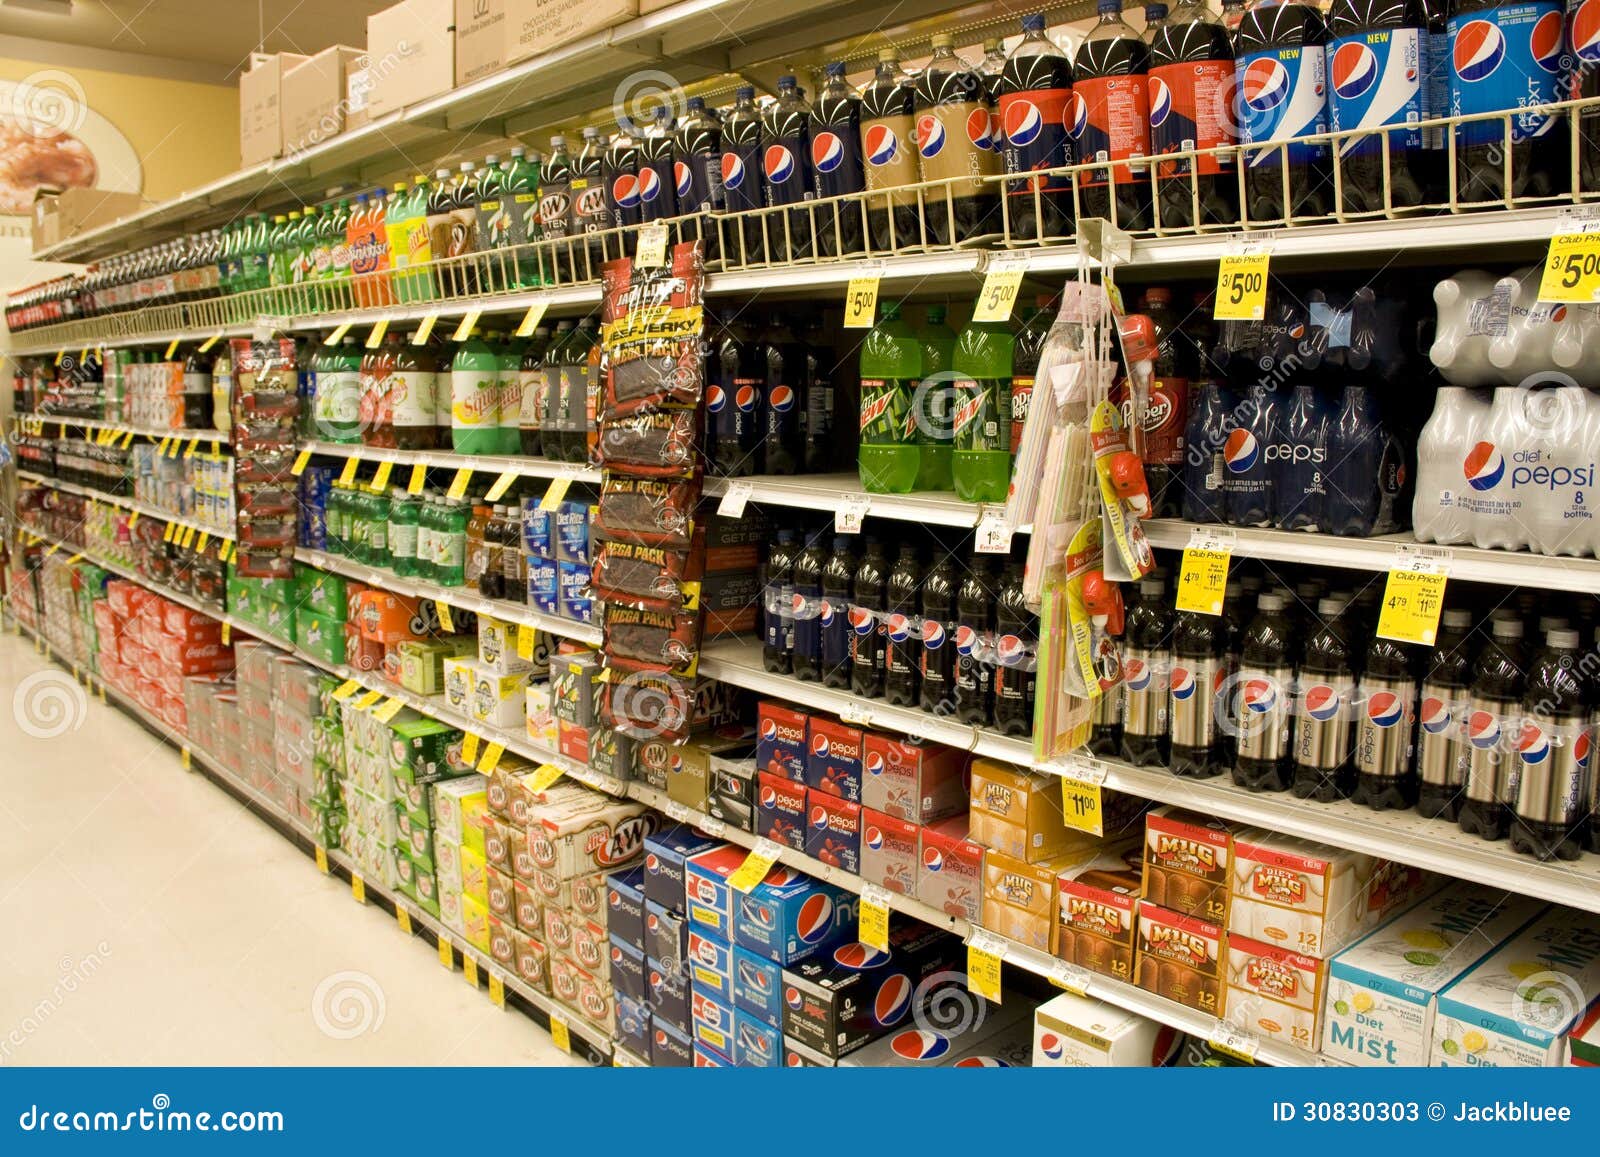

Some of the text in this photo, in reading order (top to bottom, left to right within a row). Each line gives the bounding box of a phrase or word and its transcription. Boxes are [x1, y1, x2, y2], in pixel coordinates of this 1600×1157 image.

[1367, 32, 1389, 44] NEW
[1279, 50, 1299, 60] NEW
[548, 219, 567, 229] TEN
[1559, 235, 1583, 244] Club
[1225, 256, 1242, 265] Club
[638, 318, 698, 336] JERKY
[1264, 443, 1327, 464] pepsi
[1513, 449, 1541, 463] diet
[1313, 472, 1321, 483] 8
[1511, 463, 1595, 491] pepsi
[1574, 491, 1584, 504] 8
[1564, 511, 1593, 519] bottles
[635, 546, 666, 566] PACK
[1190, 550, 1206, 559] Club
[1396, 572, 1415, 581] Club
[608, 607, 675, 630] MEGA PACK
[777, 726, 803, 740] pepsi
[1302, 719, 1313, 758] pepsi
[830, 741, 858, 756] pepsi
[1364, 726, 1375, 765] pepsi
[886, 764, 914, 778] pepsi
[987, 783, 1012, 802] MUG
[1569, 771, 1580, 813] pepsi
[777, 794, 802, 809] pepsi
[829, 814, 857, 830] pepsi
[885, 837, 914, 855] pepsi
[1161, 836, 1214, 867] MUG
[658, 864, 682, 881] pepsi
[945, 860, 977, 877] pepsi
[1166, 861, 1204, 875] ROOT BEER
[1266, 868, 1294, 880] DIET
[1005, 873, 1033, 894] MUG
[1257, 873, 1302, 896] MUG
[698, 886, 717, 899] PEPSI
[622, 901, 641, 917] pepsi
[1071, 898, 1121, 928] MUG
[1207, 900, 1225, 916] 12
[1152, 925, 1207, 957] MUG
[1298, 931, 1317, 947] 12
[1111, 958, 1127, 974] 12
[1178, 953, 1197, 967] BEER
[1251, 966, 1294, 991] MUG
[845, 998, 851, 1009] 0
[1198, 991, 1215, 1005] 12
[703, 1006, 720, 1019] PEPSI
[1355, 1013, 1384, 1031] Diet
[1291, 1025, 1310, 1041] 12
[1331, 1020, 1397, 1065] Mist
[668, 1043, 689, 1059] pepsi
